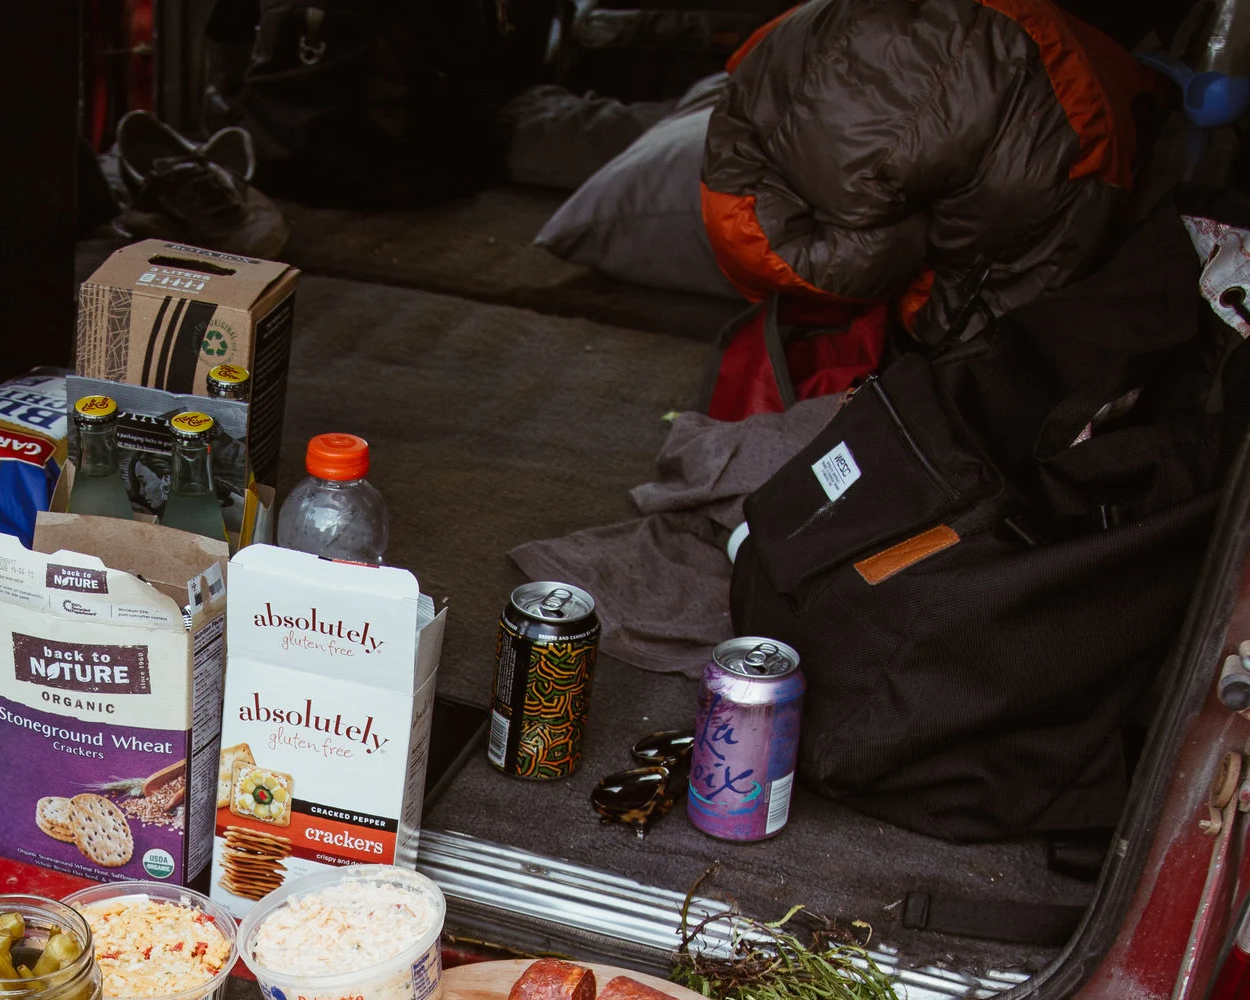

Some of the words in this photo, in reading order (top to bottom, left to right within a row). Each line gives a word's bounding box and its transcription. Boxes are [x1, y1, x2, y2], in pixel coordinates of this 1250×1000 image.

[162, 268, 211, 281] LITERS
[62, 568, 80, 577] back
[253, 602, 385, 654] absolutely
[281, 630, 325, 652] gluten
[327, 640, 356, 657] free
[43, 646, 84, 662] back
[91, 650, 111, 663] to
[137, 651, 145, 670] 1960
[41, 690, 116, 714] ORGANIC
[238, 692, 391, 755] absolutely
[52, 741, 105, 760] Crackers
[110, 734, 173, 755] Wheat
[268, 726, 319, 754] gluten
[321, 738, 355, 759] free
[310, 806, 351, 821] CRACKED
[352, 815, 386, 828] PEPPER
[304, 827, 384, 855] crackers
[16, 847, 37, 858] Organic
[38, 853, 73, 867] Stoneground
[74, 863, 93, 873] Wheat
[34, 859, 52, 868] Whole
[149, 854, 168, 864] USDA
[315, 853, 337, 865] crispy
[337, 857, 351, 866] and
